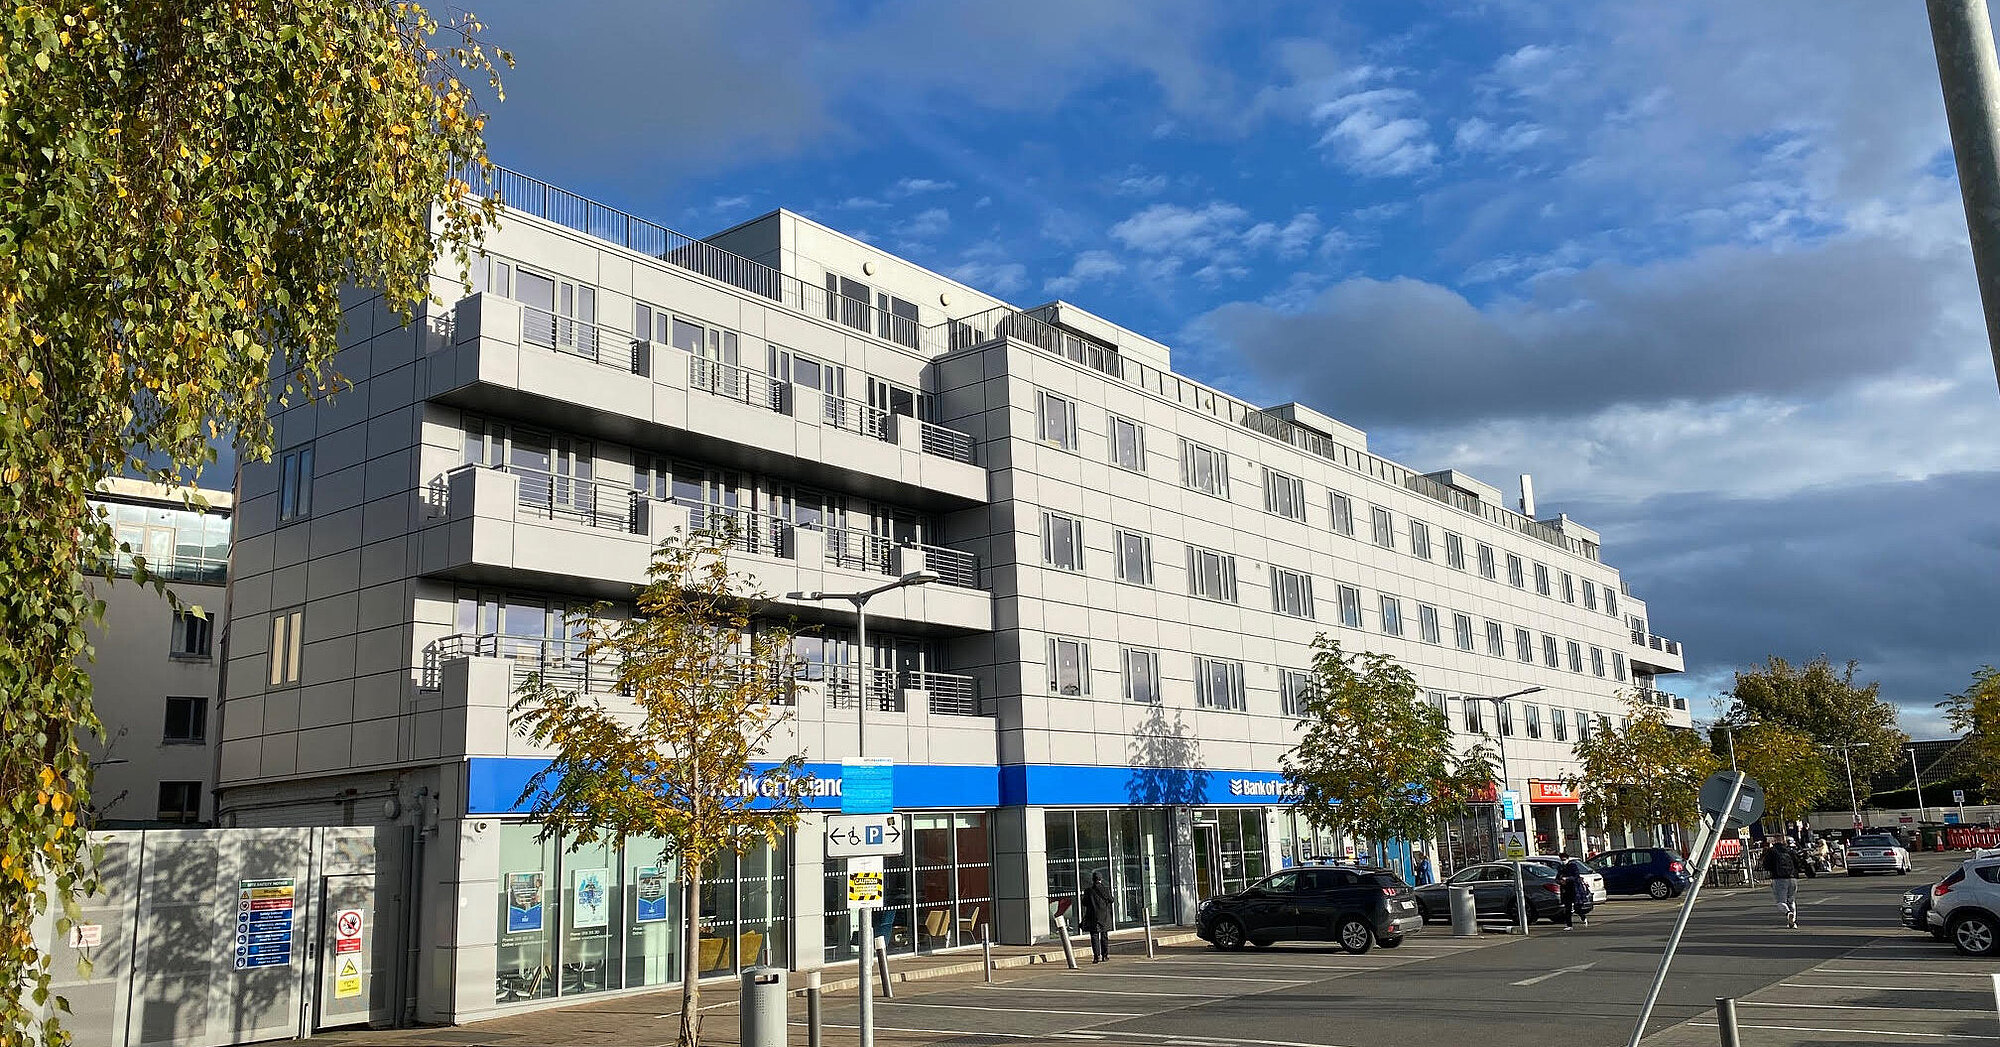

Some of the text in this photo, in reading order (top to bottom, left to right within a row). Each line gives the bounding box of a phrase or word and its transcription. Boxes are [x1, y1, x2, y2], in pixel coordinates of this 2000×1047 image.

[1243, 779, 1266, 796] Bank
[1266, 780, 1275, 796] of
[1543, 784, 1562, 795] SPAR
[869, 827, 880, 843] P
